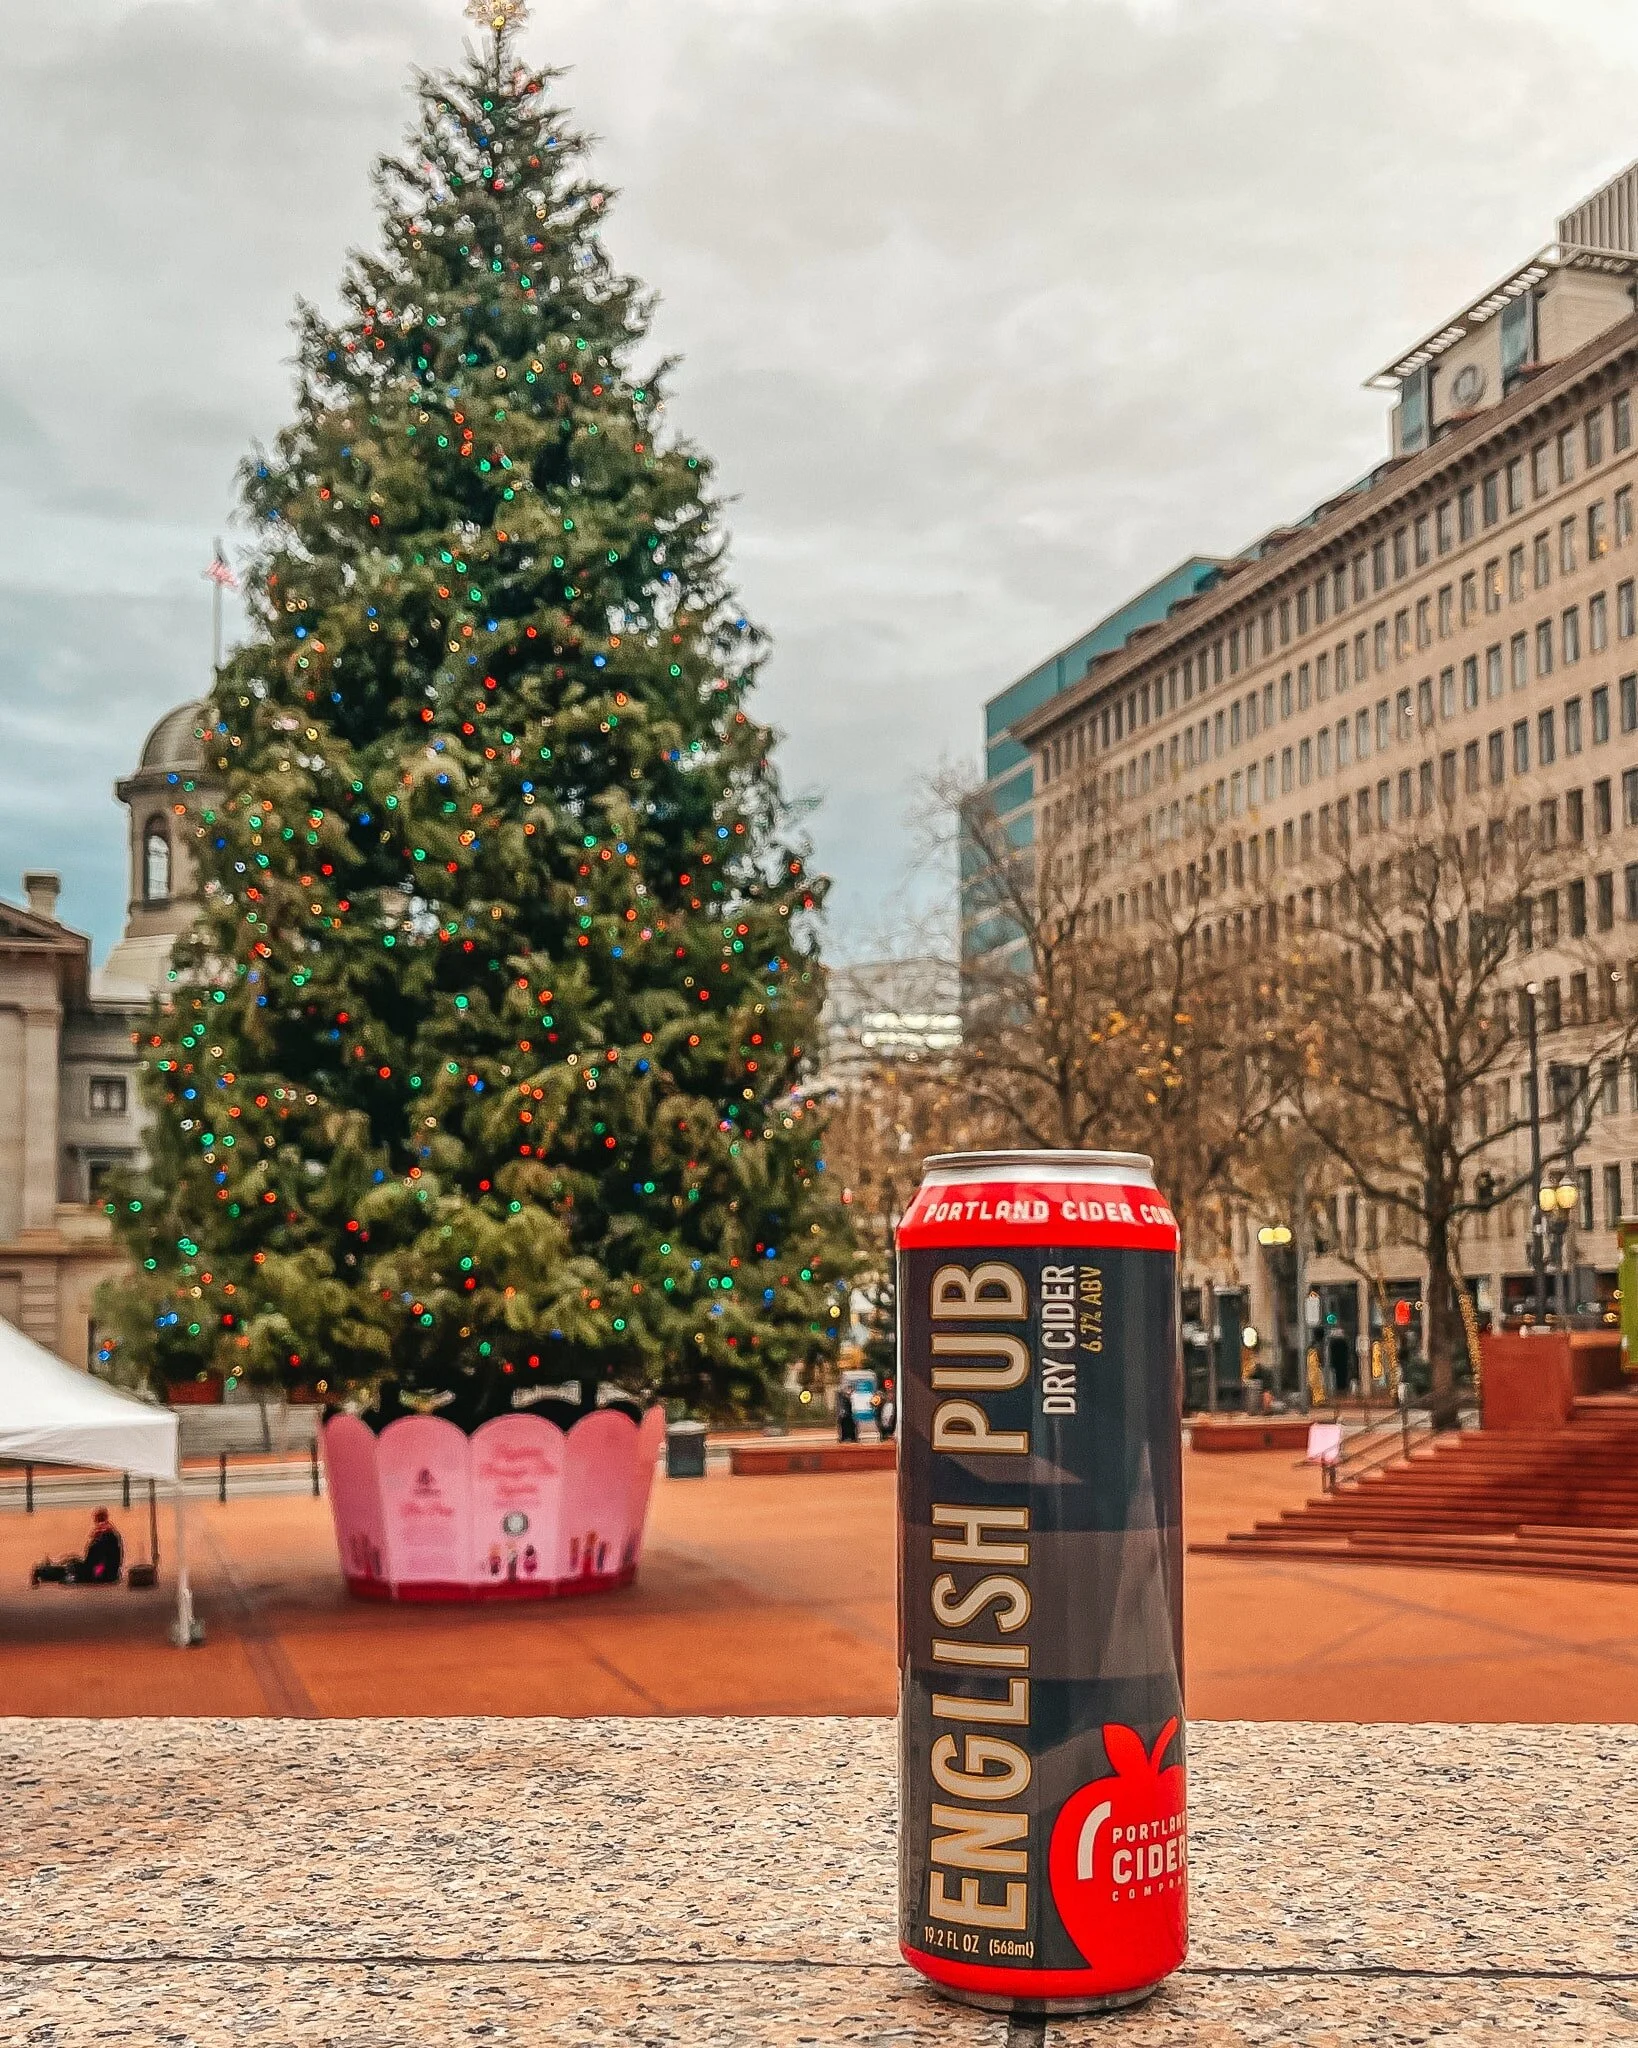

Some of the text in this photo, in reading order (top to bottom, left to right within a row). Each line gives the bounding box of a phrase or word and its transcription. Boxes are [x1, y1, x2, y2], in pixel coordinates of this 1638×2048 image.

[923, 1200, 1050, 1223] PORTLAND
[1062, 1201, 1135, 1222] CIDER
[1041, 1265, 1077, 1415] DRY CIDER
[1080, 1266, 1103, 1352] 6.7% ABV
[929, 1261, 1031, 1931] ENGLISH PUB
[1112, 1834, 1186, 1884] CIDER
[924, 1926, 1035, 1960] 19.2 FL OZ (568ml)
